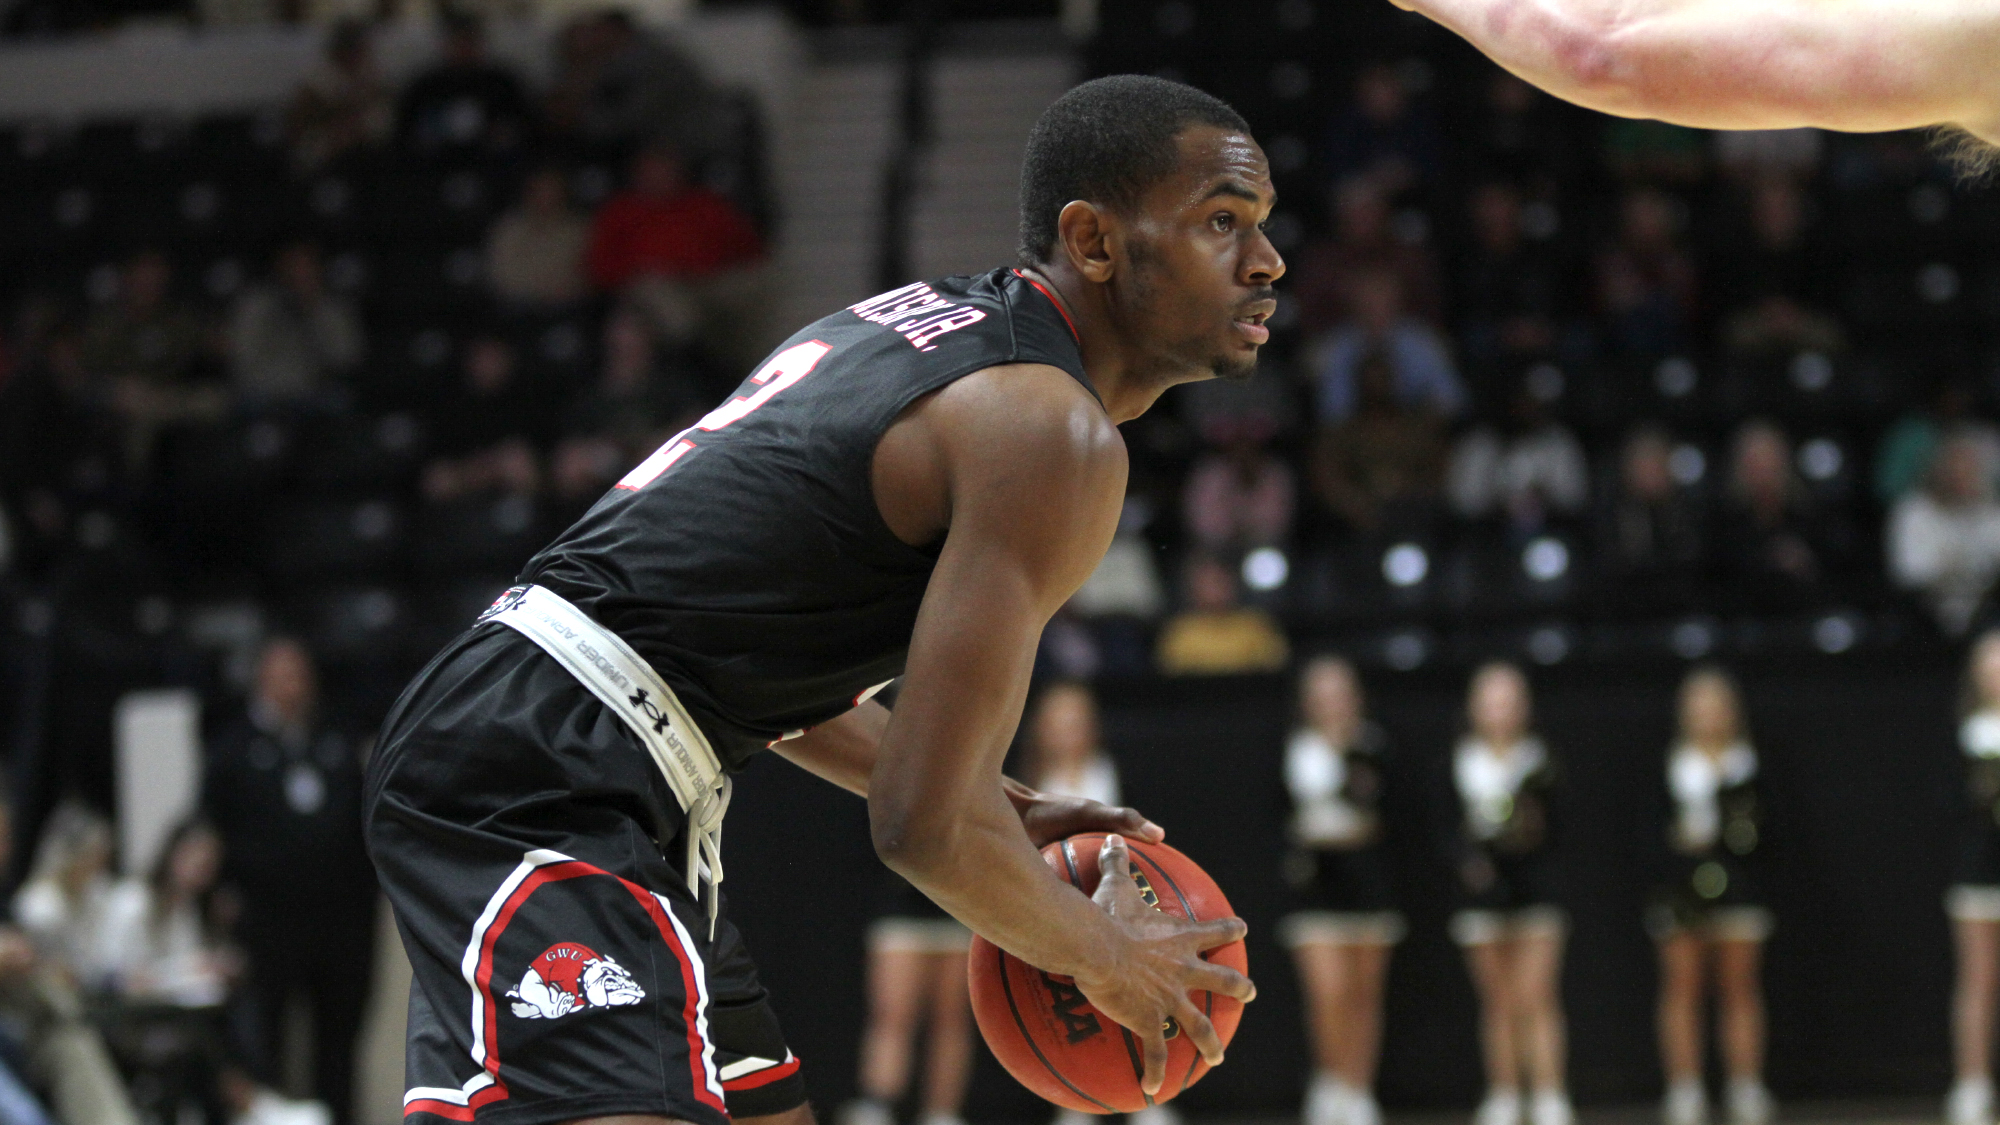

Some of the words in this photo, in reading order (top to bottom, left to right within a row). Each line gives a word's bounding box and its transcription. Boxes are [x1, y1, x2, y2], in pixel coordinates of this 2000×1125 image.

[894, 305, 988, 352] JR.
[615, 339, 834, 492] 2
[576, 640, 629, 689] UNDER
[666, 732, 699, 778] ARMOUR
[692, 774, 708, 798] DER
[545, 948, 583, 962] GWU
